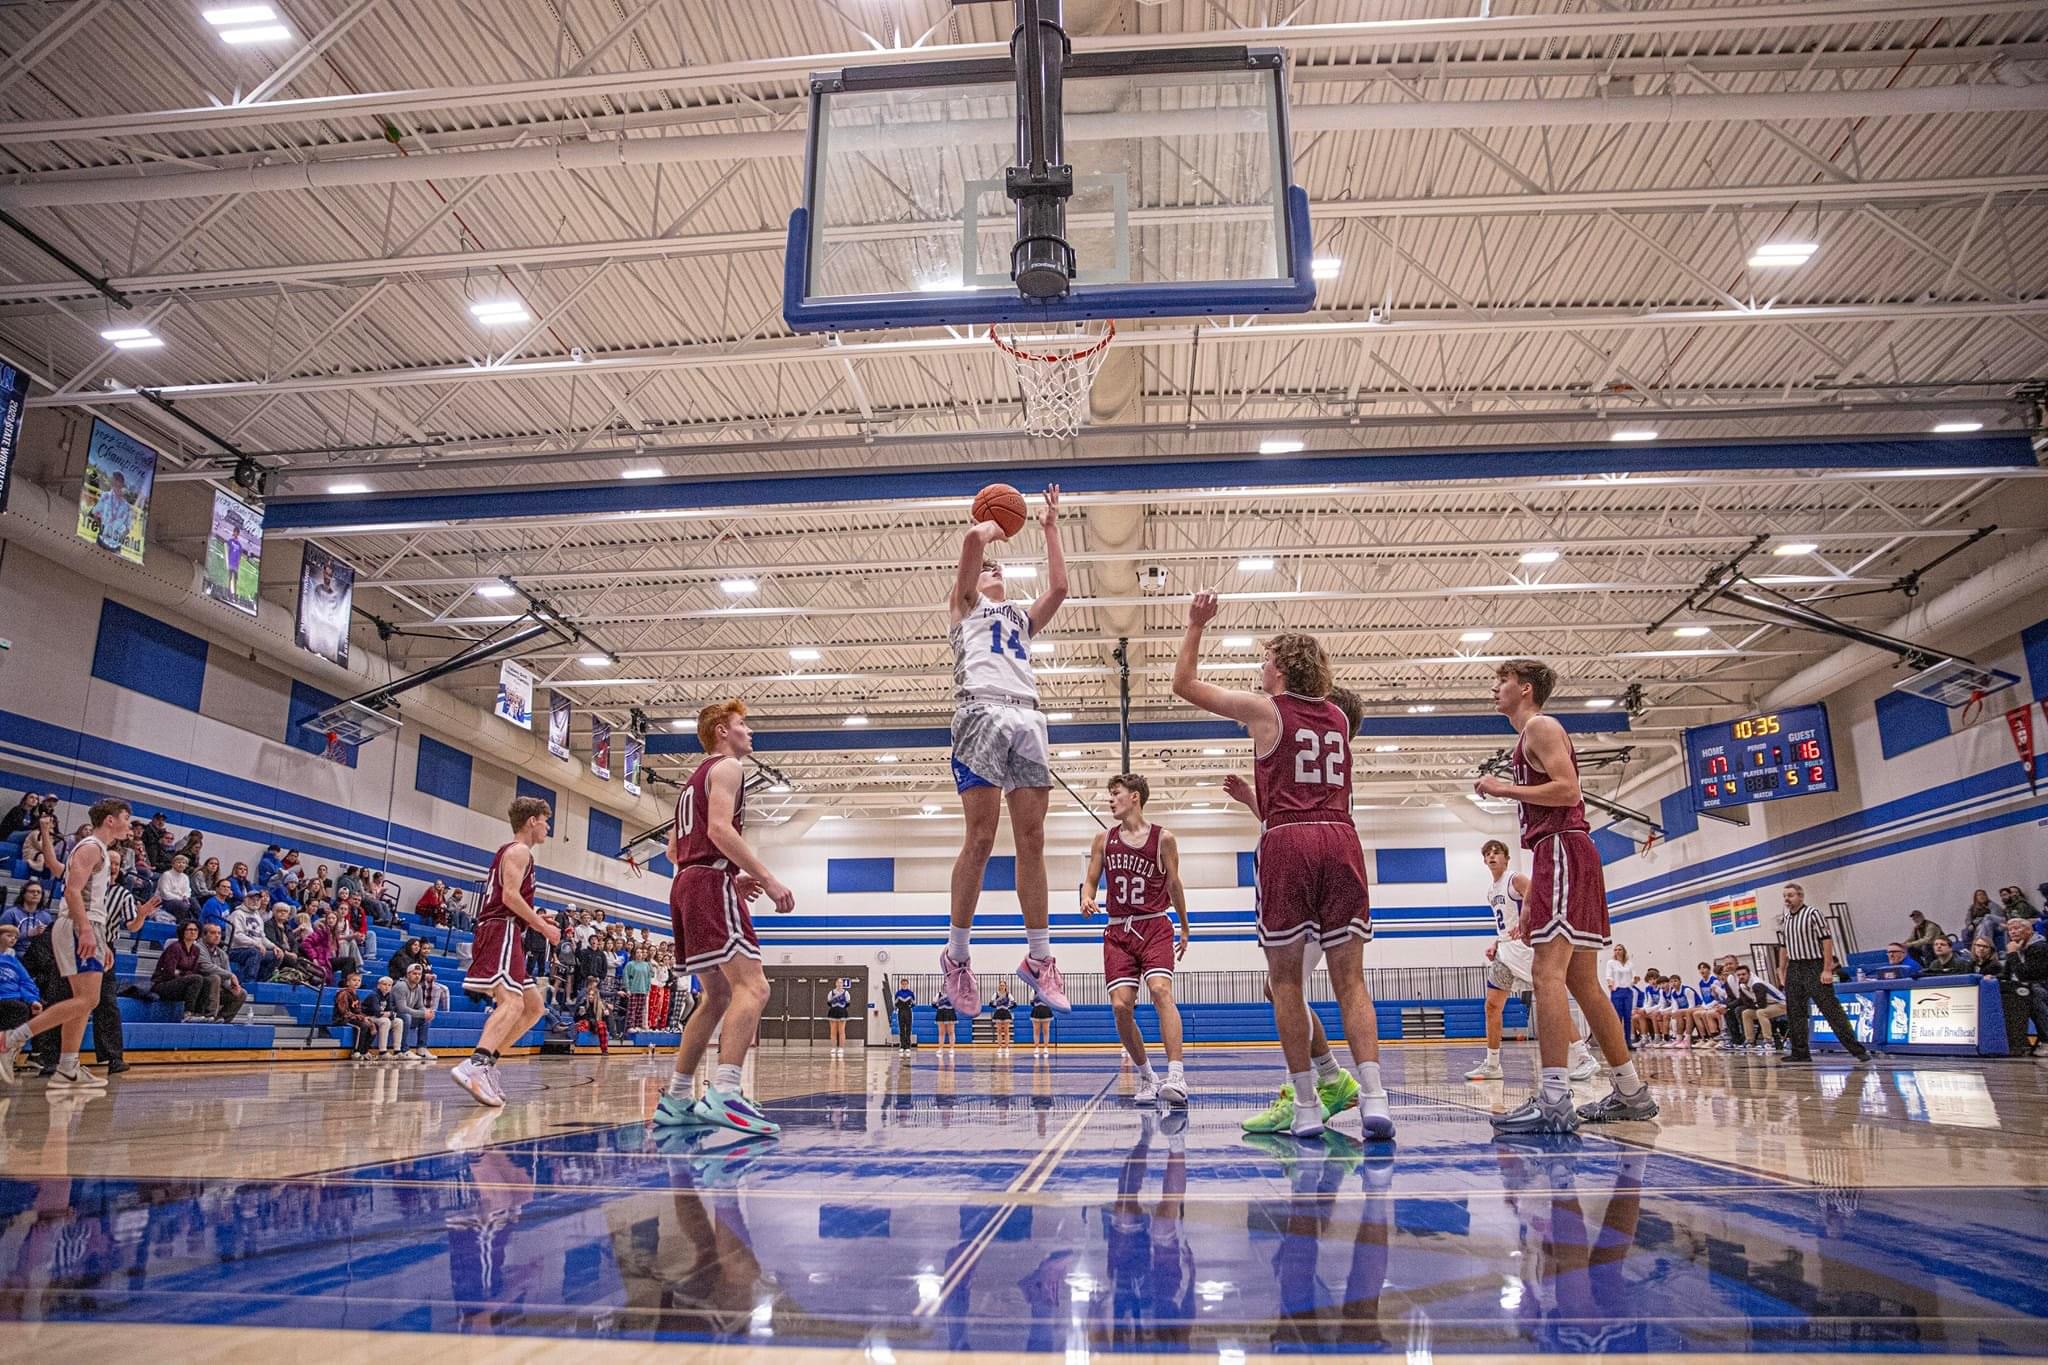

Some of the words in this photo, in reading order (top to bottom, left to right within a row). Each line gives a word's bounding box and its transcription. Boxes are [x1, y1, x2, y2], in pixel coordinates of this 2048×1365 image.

[3, 422, 15, 448] STATE
[989, 620, 1027, 660] 14
[1733, 715, 1780, 739] 10:35
[1788, 729, 1816, 742] GUEST
[1701, 746, 1724, 758] HOME
[1802, 740, 1820, 760] 16
[1294, 728, 1345, 787] 22
[1755, 752, 1764, 765] 1
[1711, 756, 1727, 774] 17
[1786, 771, 1798, 785] 5
[1813, 766, 1823, 781] 2
[1707, 784, 1718, 797] 4
[1725, 781, 1737, 794] 4
[1114, 876, 1146, 905] 32
[1849, 1002, 1861, 1015] TO
[1912, 1007, 1949, 1018] BURTNESS
[1919, 1026, 1935, 1038] Bank
